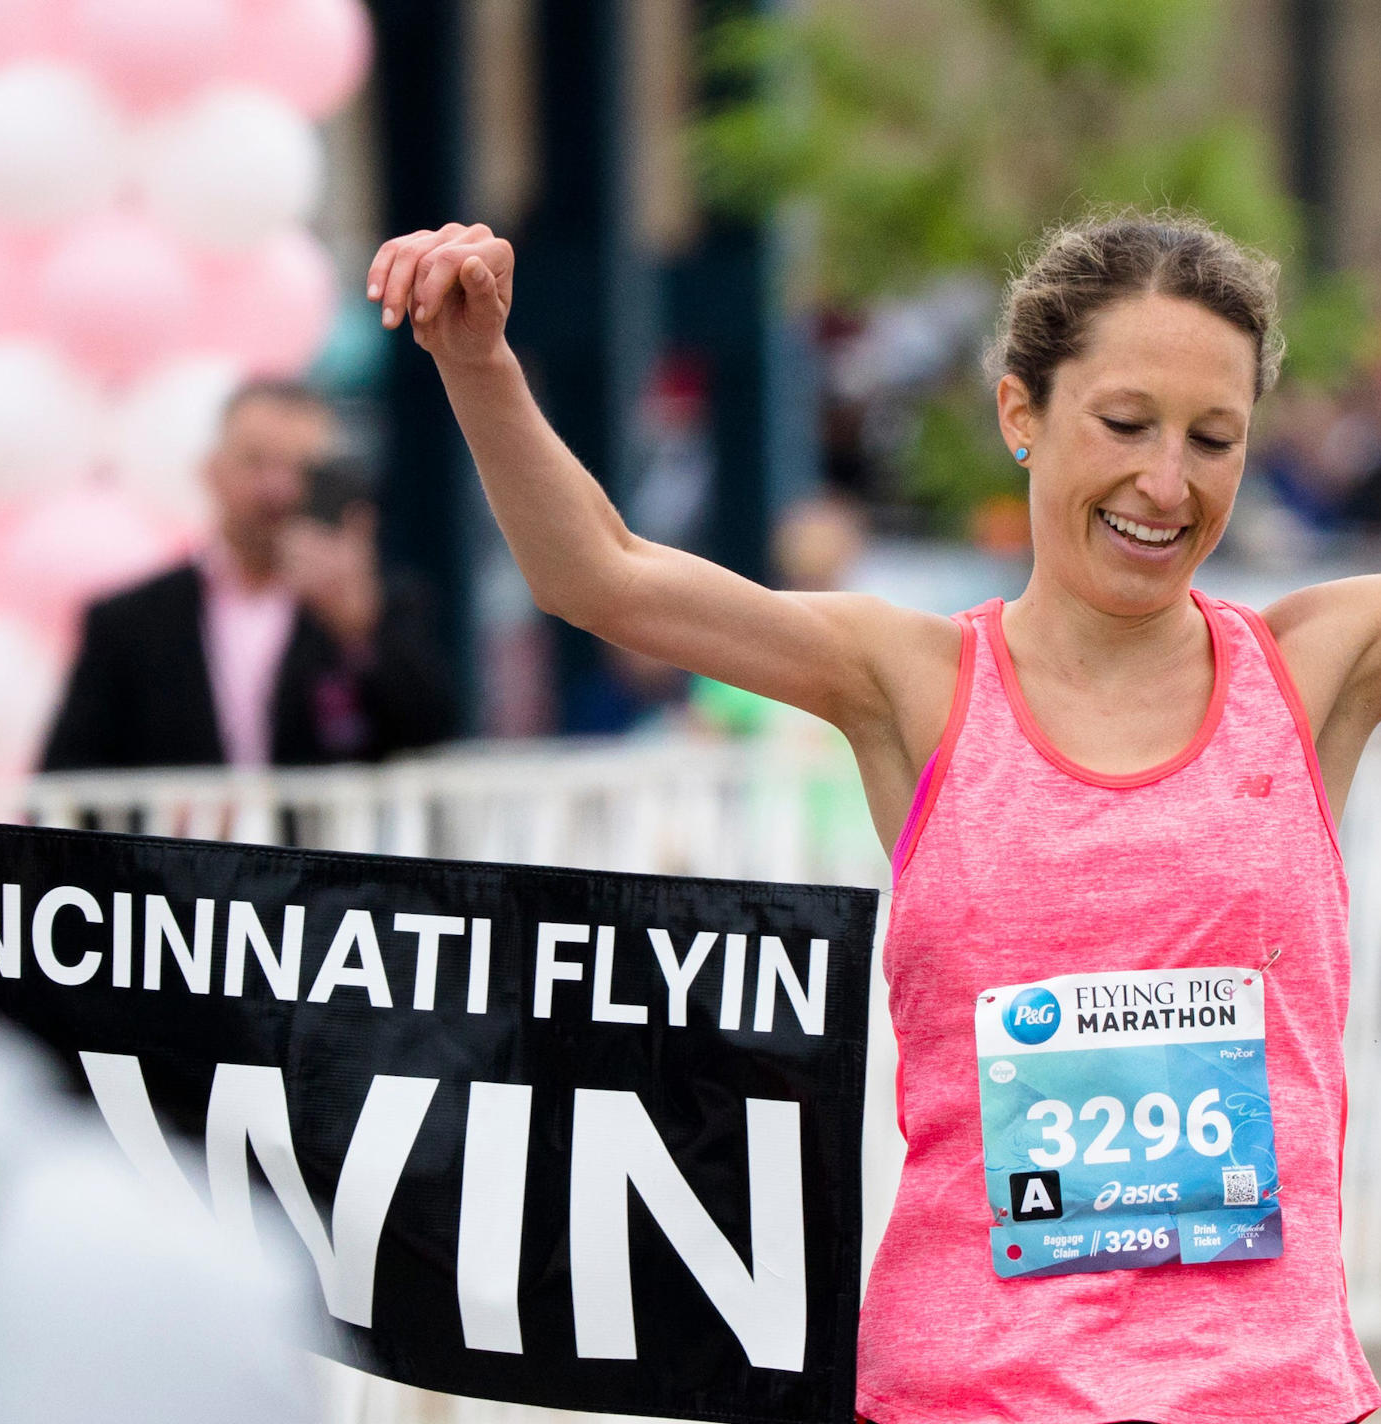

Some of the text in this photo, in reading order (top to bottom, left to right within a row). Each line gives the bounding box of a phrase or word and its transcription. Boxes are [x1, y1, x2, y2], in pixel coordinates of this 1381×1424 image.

[533, 922, 829, 1037] FLYIN
[1075, 978, 1237, 1010] FLYING PIG
[1014, 1003, 1056, 1027] P&G
[1077, 1005, 1236, 1035] MARATHON
[1219, 1047, 1256, 1061] Paycor
[1026, 1088, 1234, 1169] 3296
[1020, 1178, 1055, 1213] A
[78, 1050, 806, 1374] WIN
[1043, 1234, 1084, 1247] Baggage
[1104, 1226, 1170, 1253] 3296
[1193, 1224, 1217, 1235] Drink
[1193, 1236, 1221, 1247] Ticket
[1052, 1248, 1080, 1259] Claim
